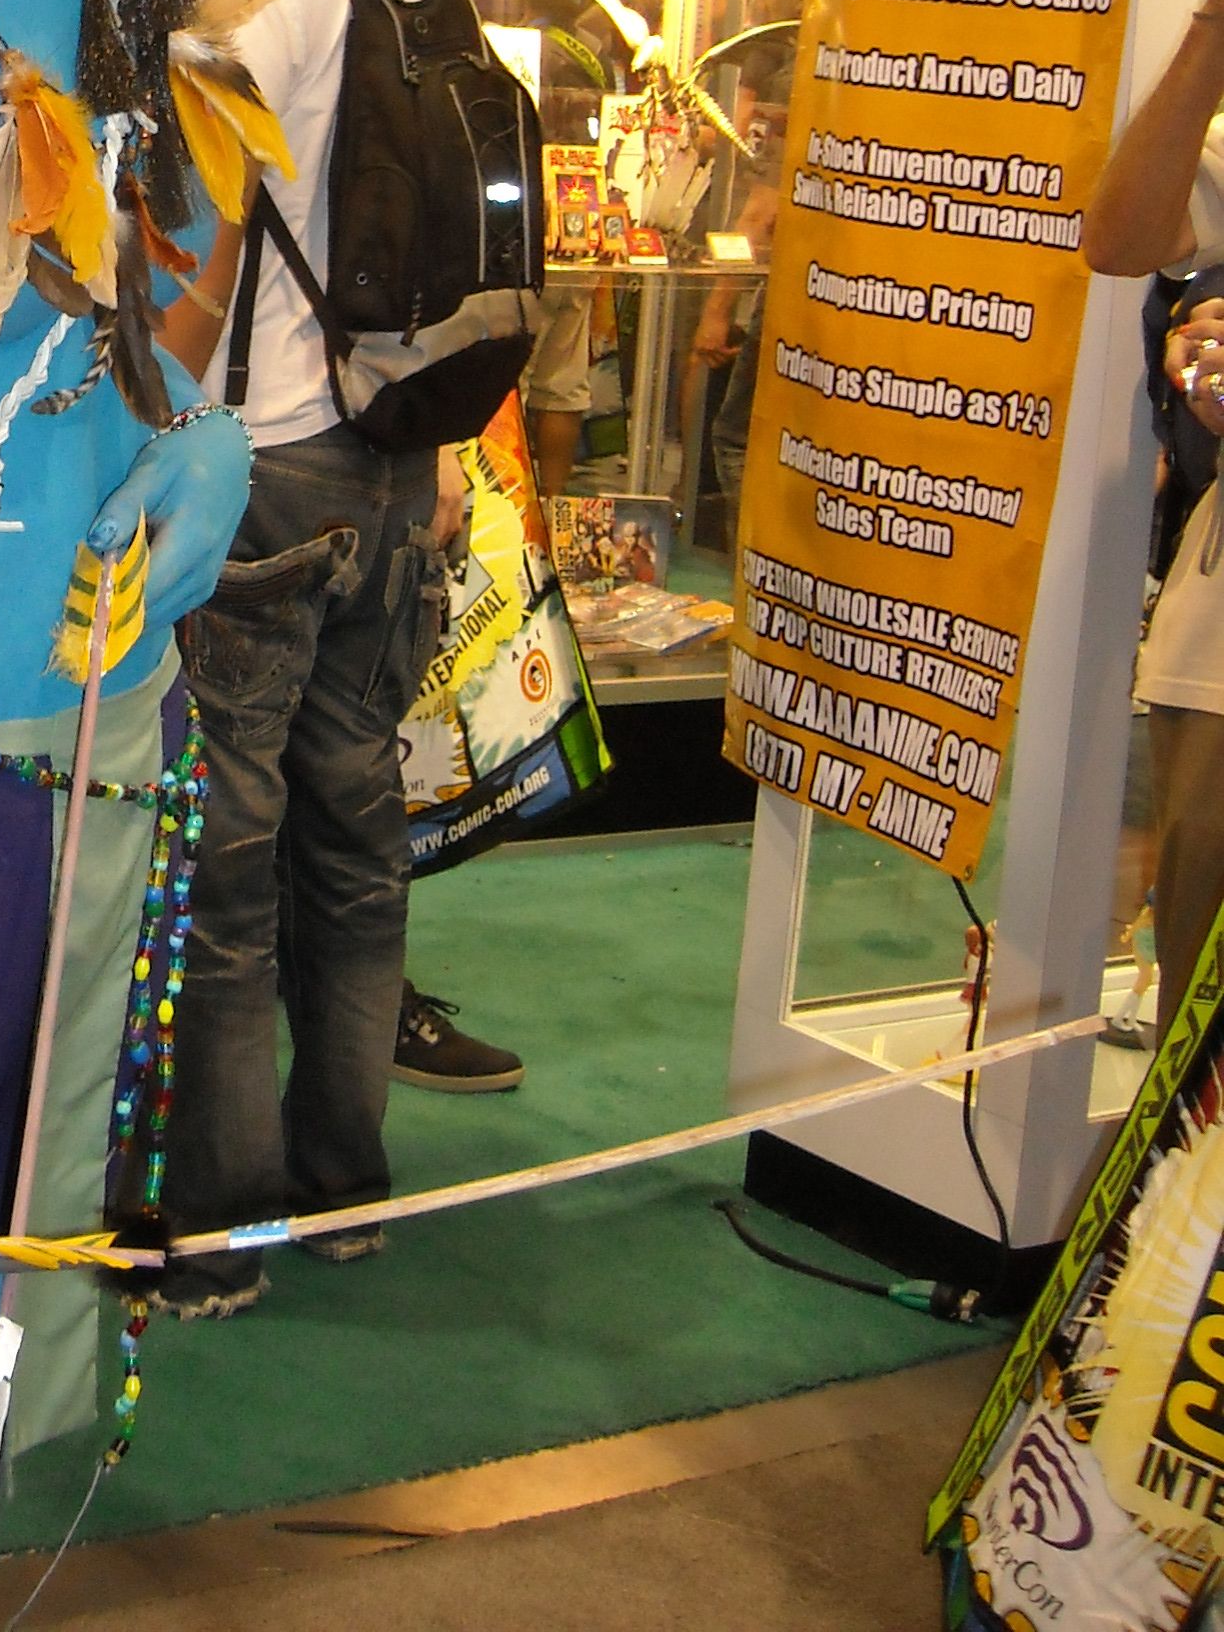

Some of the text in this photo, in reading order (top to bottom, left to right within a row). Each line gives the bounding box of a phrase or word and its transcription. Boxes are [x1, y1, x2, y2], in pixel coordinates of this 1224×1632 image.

[918, 54, 1009, 99] Arrive
[1012, 61, 1085, 109] Daily
[867, 138, 1005, 196] Inventory
[1006, 154, 1047, 197] for
[1045, 165, 1063, 200] a
[833, 181, 927, 229] Reliable
[931, 194, 1083, 251] Turnaround
[807, 261, 1034, 341] Competitive Pricing
[776, 338, 1052, 438] Ordering as Simple as 1-2-3
[779, 428, 1023, 527] Dedicated Professional
[816, 489, 954, 557] Sales Team
[770, 603, 809, 649] POP
[809, 621, 905, 682] CULTURE
[905, 649, 1004, 719] RETAILERS!
[815, 577, 952, 649] WHOLESALE
[950, 614, 1020, 676] SERVICE
[409, 765, 551, 858] WW.COMIC-CON.ORG
[744, 720, 805, 794] (877)
[809, 751, 865, 816] MY
[867, 778, 956, 861] ANIME
